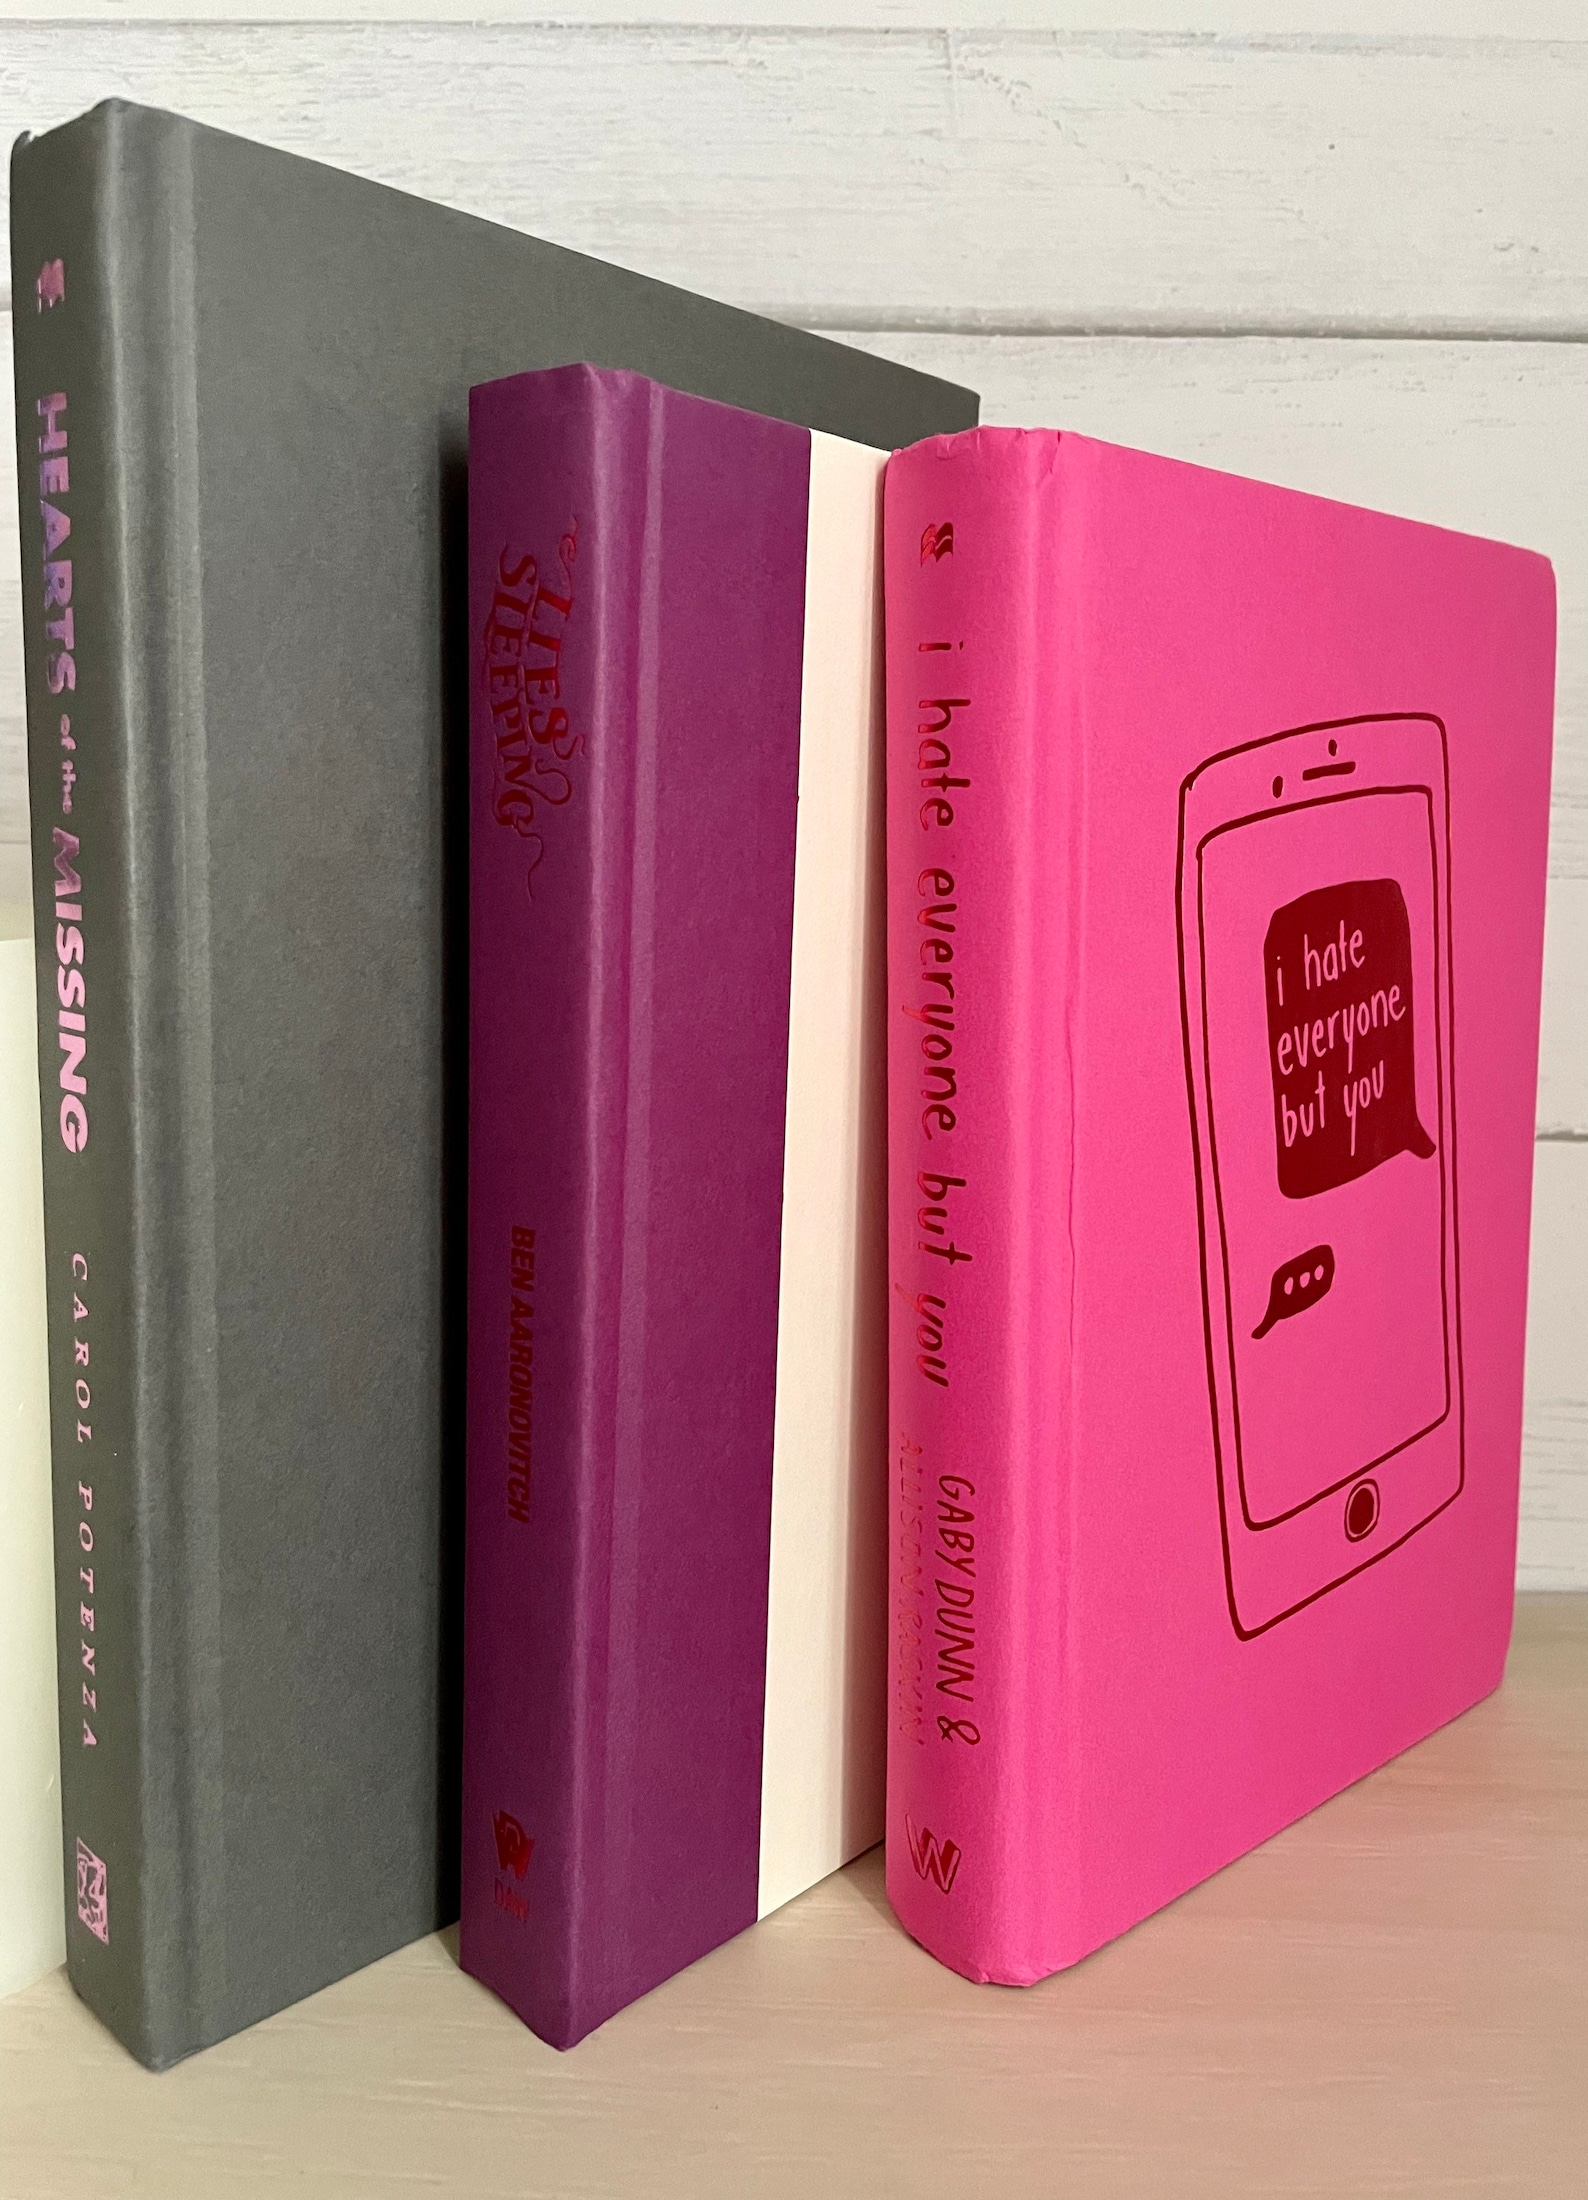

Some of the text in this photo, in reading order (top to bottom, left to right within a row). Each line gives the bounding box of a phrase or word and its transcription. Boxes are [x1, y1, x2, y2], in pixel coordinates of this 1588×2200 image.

[38, 392, 77, 694] HEARTS
[525, 540, 584, 758] LIES
[484, 540, 552, 850] SLEEPING
[53, 827, 88, 1153] MISSING
[895, 640, 973, 1388] i hate everyone but you
[1276, 919, 1365, 1006] i hate
[1277, 985, 1406, 1074] everyone
[1281, 1060, 1384, 1156] but you
[72, 1253, 97, 1746] CAROL POTENZA
[508, 1226, 535, 1524] BEN AARONOVITCH
[934, 1475, 981, 1745] GABY DUNN &
